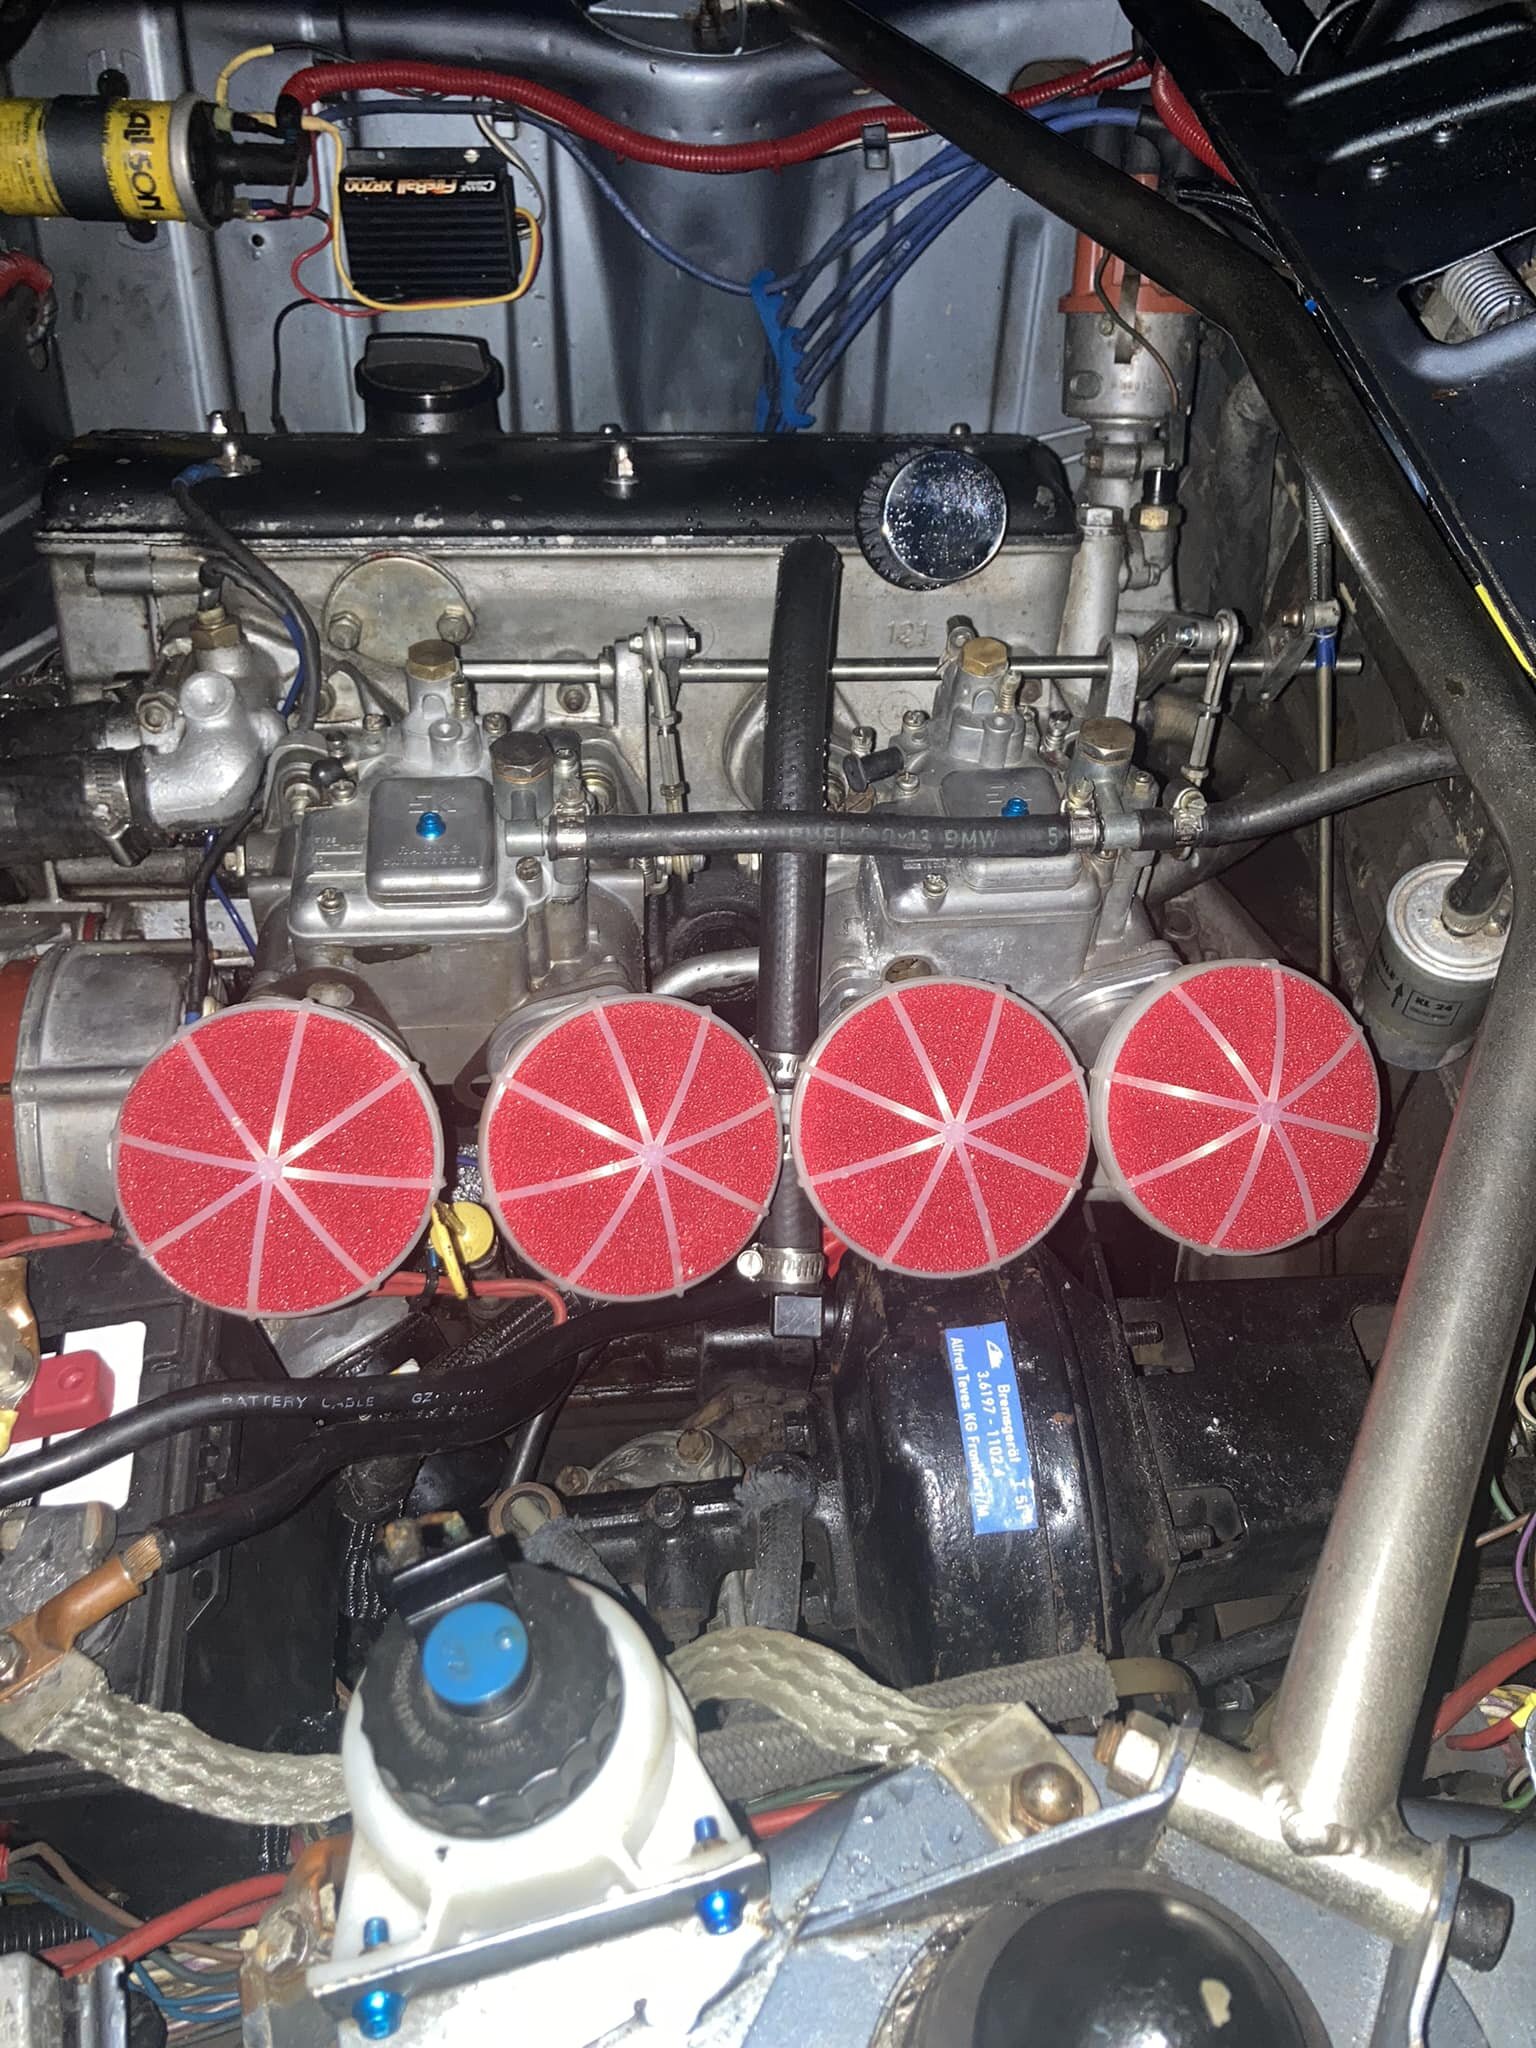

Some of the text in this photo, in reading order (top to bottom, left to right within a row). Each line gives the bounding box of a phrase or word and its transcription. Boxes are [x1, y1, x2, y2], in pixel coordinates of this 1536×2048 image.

[943, 828, 1000, 849] BMW
[949, 1336, 969, 1371] Alfred
[957, 1373, 971, 1410] Teves
[976, 1370, 997, 1414] 3.6197
[963, 1412, 978, 1433] KG
[986, 1429, 1006, 1478] 1102.4
